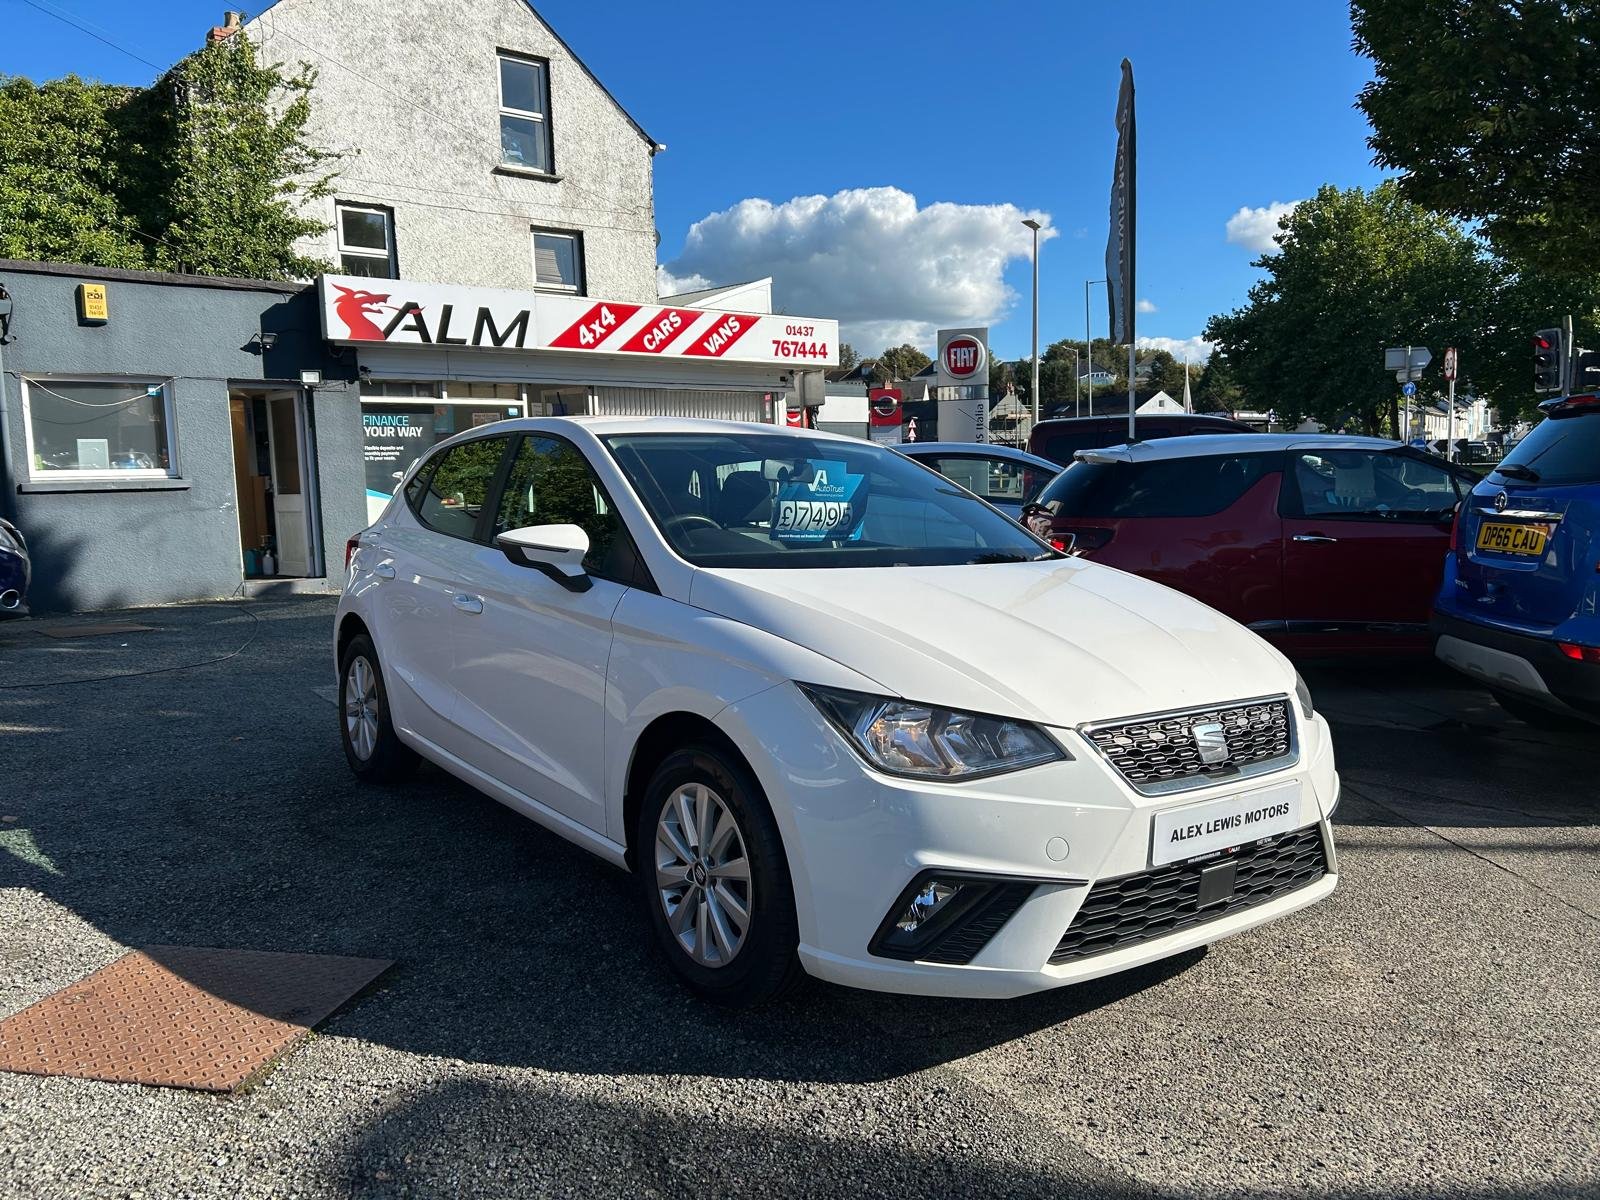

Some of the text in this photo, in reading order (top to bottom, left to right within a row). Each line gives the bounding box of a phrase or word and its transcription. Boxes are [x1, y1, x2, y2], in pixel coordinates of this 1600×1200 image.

[384, 301, 531, 348] ALM
[579, 305, 616, 347] 4x4
[642, 311, 682, 350] CARS
[703, 315, 740, 354] VANS
[785, 325, 815, 337] 01437
[772, 339, 828, 359] 767444
[950, 346, 976, 368] FIAT
[362, 415, 409, 426] FINANCE
[363, 426, 423, 437] YOUR WAY
[816, 485, 844, 493] AutoTrust
[1482, 525, 1540, 550] DP66 CAU
[1170, 802, 1290, 843] ALEX LEWIS MOTORS
